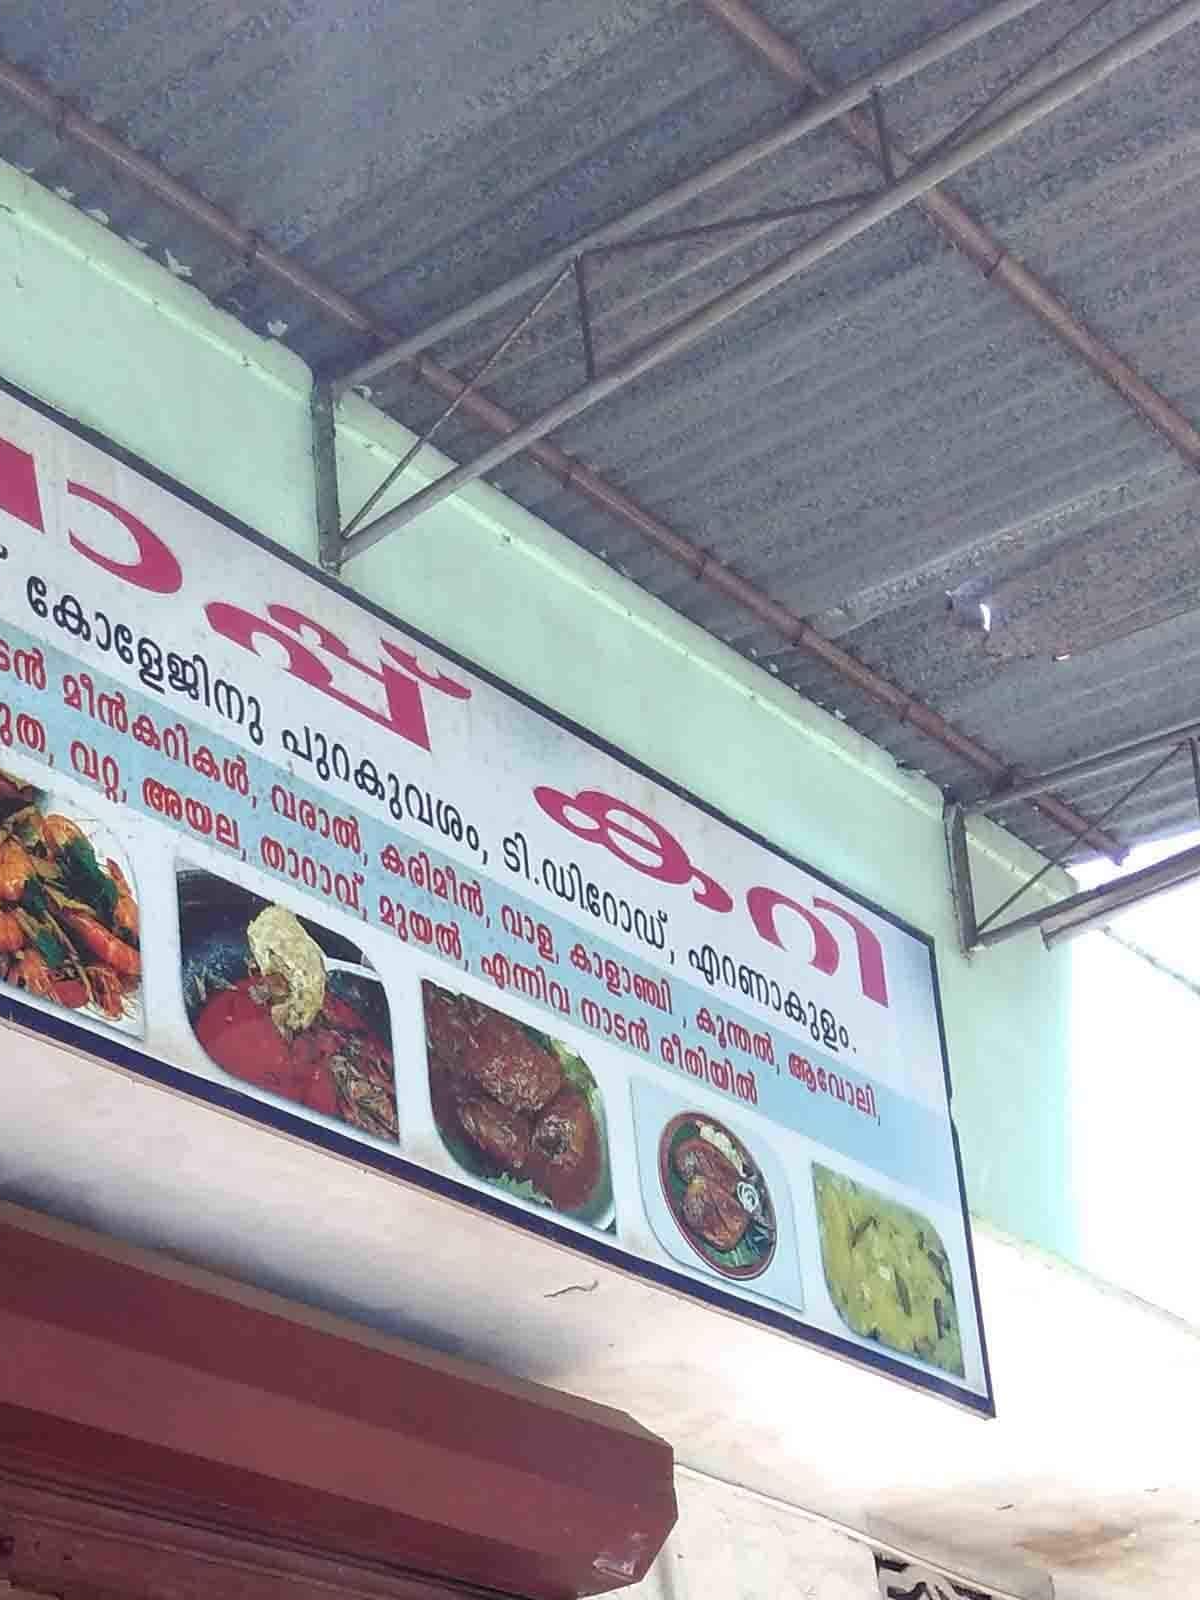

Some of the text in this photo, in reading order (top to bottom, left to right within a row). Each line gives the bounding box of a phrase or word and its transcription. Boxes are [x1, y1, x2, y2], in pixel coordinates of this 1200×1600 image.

[25, 574, 264, 746] കോളേജിനു
[280, 724, 488, 865] പുറകുവശം,
[500, 903, 560, 965] വാള,
[531, 784, 889, 1009] കറി
[479, 951, 571, 1015] എന്നിവ
[579, 996, 650, 1053] നാടൻ
[659, 1032, 758, 1105] രീതിയിൽ
